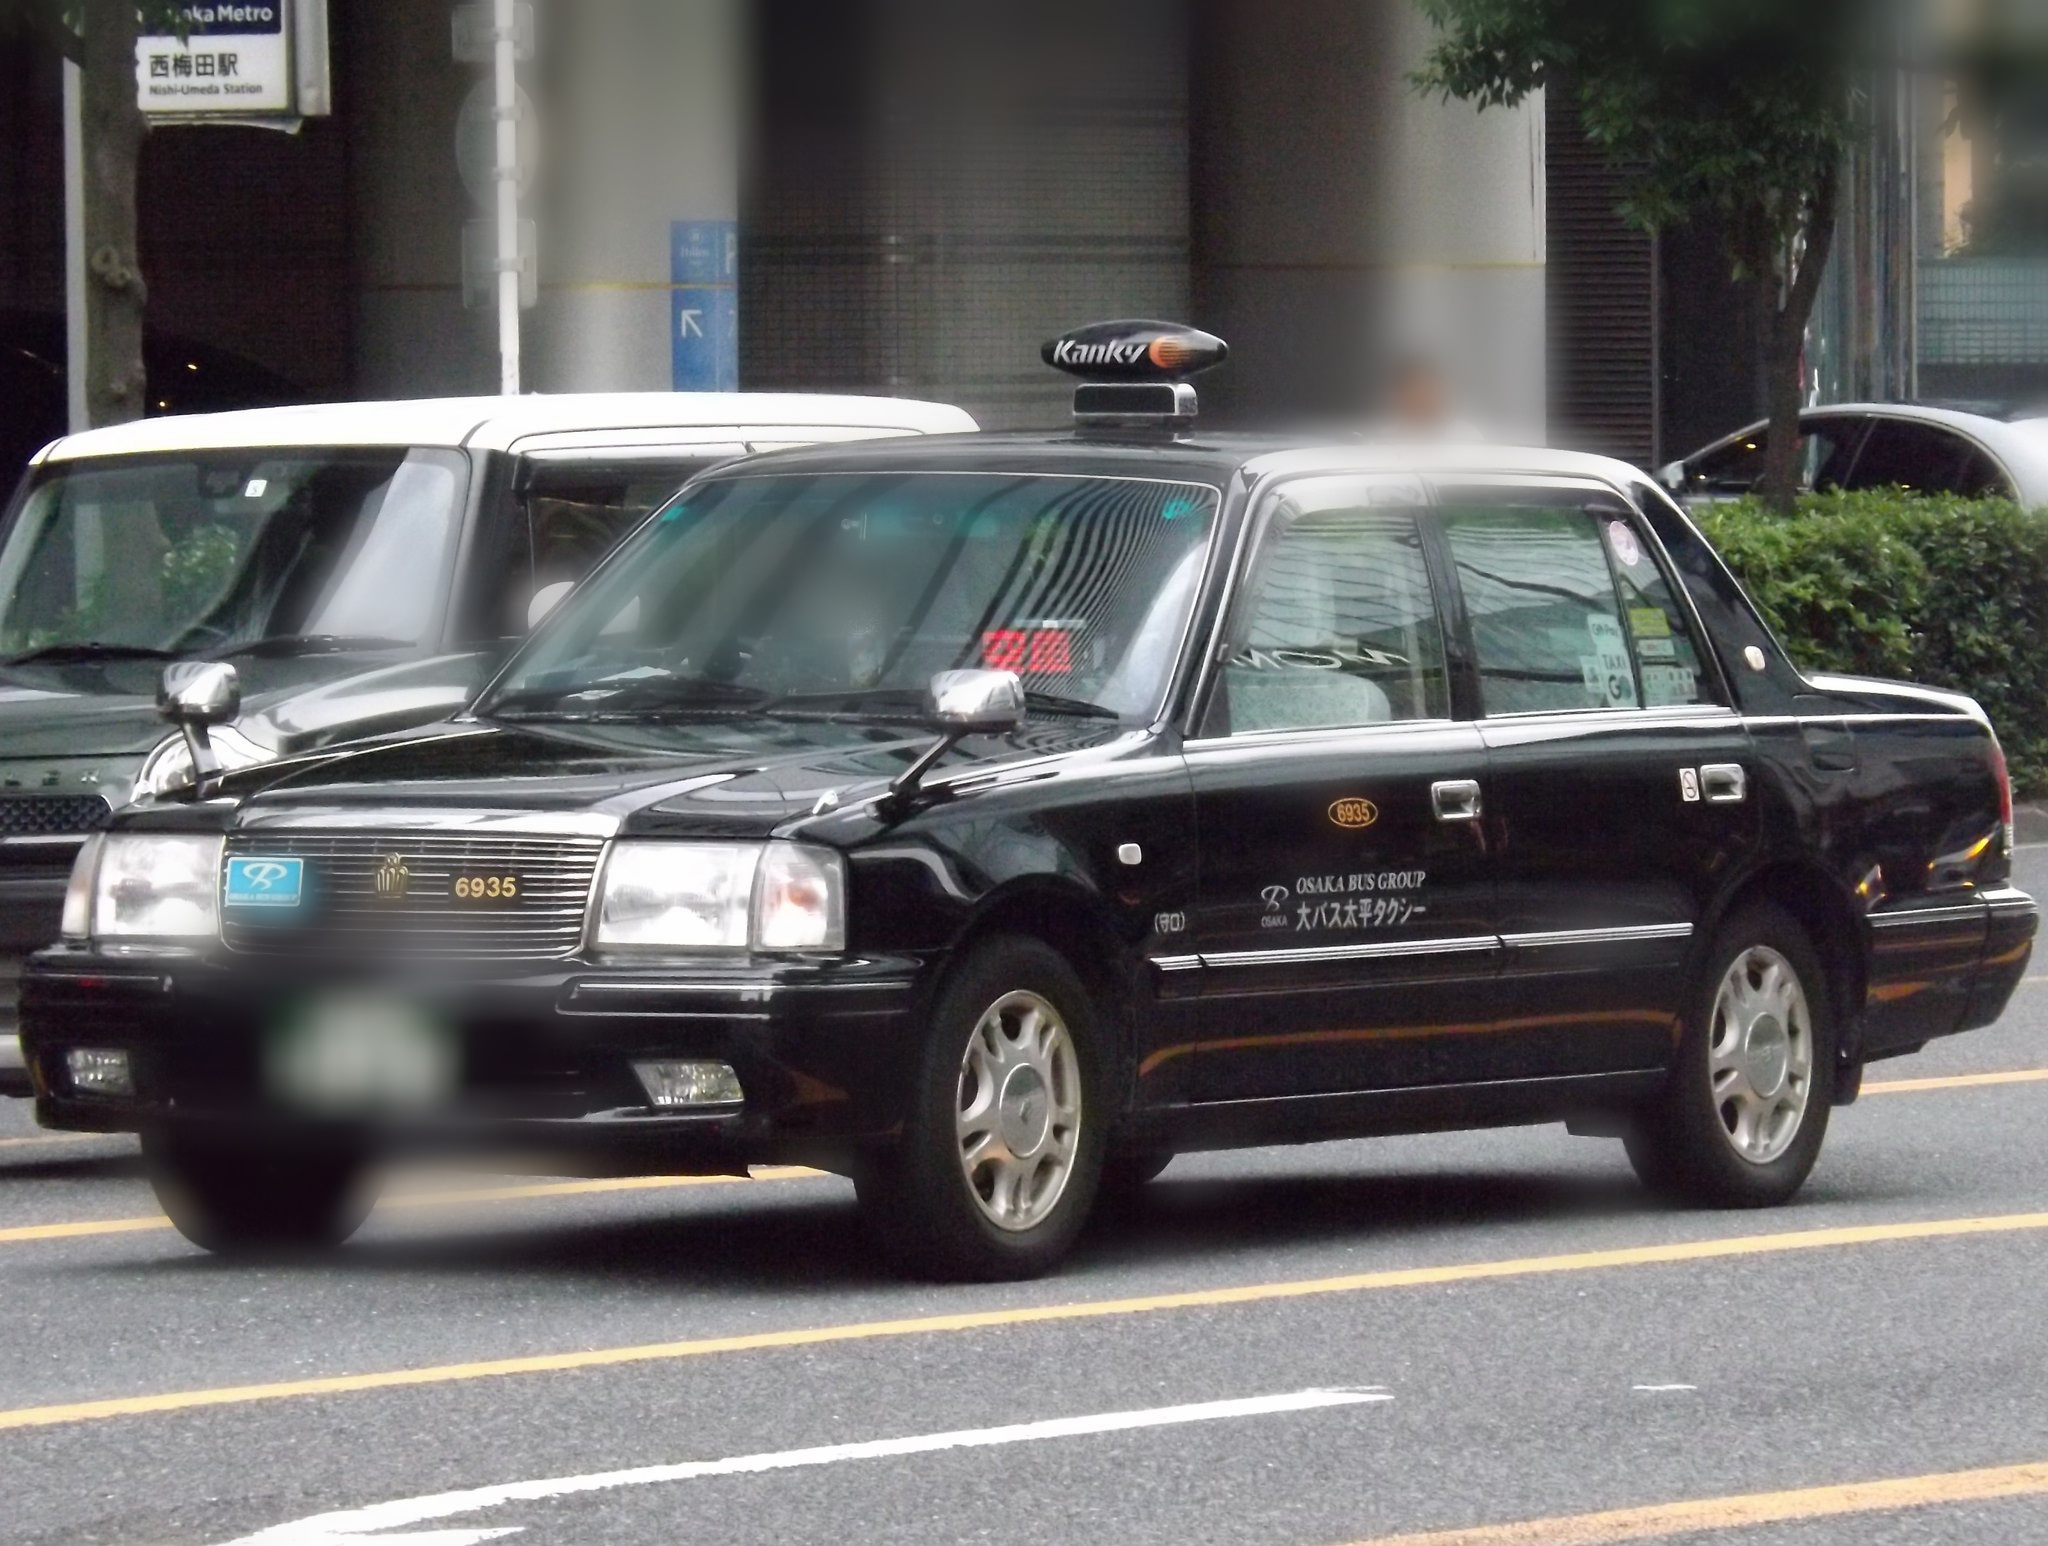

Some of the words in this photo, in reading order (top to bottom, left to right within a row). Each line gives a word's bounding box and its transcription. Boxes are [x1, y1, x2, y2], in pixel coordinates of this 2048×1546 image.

[217, 5, 273, 22] Metro
[149, 53, 238, 78] 西梅田駅
[148, 84, 220, 96] Nishi-Umeda
[223, 83, 263, 95] Station
[1053, 339, 1147, 364] Kanky
[1337, 803, 1370, 823] 6935
[455, 876, 516, 898] 6935
[1296, 875, 1345, 894] OSAKA
[1349, 873, 1375, 891] BUS
[1377, 871, 1426, 890] GROUP
[1261, 915, 1288, 928] OSAKA
[1296, 898, 1426, 931] 大バス太平タクシー
